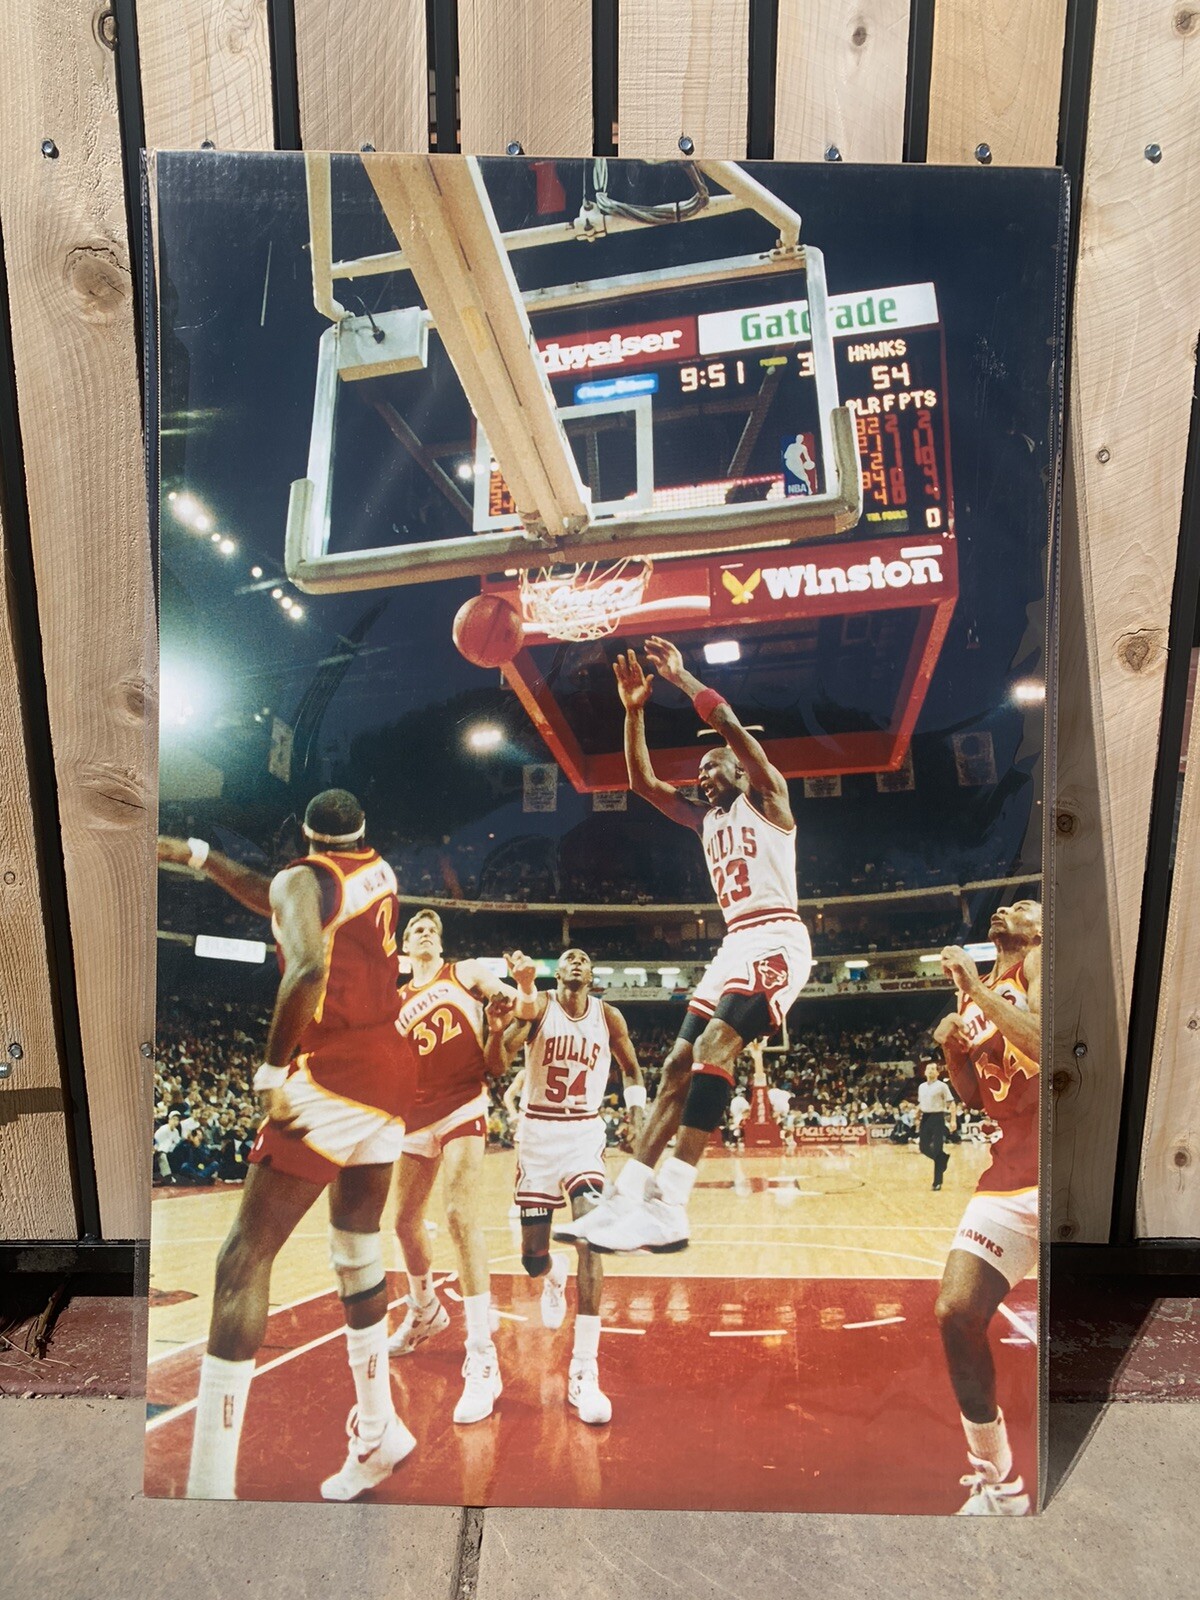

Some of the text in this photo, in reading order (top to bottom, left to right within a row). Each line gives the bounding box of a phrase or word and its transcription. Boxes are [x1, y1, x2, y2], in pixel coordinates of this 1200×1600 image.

[539, 329, 683, 374] dweiser
[847, 338, 908, 364] HAWKS
[871, 362, 912, 390] 54
[899, 390, 937, 411] PTS
[787, 483, 808, 494] NBA
[925, 507, 942, 528] 0
[761, 556, 944, 600] Winston
[713, 857, 752, 908] 23
[413, 1007, 463, 1057] 32
[542, 1034, 601, 1073] BULLS
[545, 1066, 588, 1105] 54
[960, 1228, 1004, 1258] HAWKS
